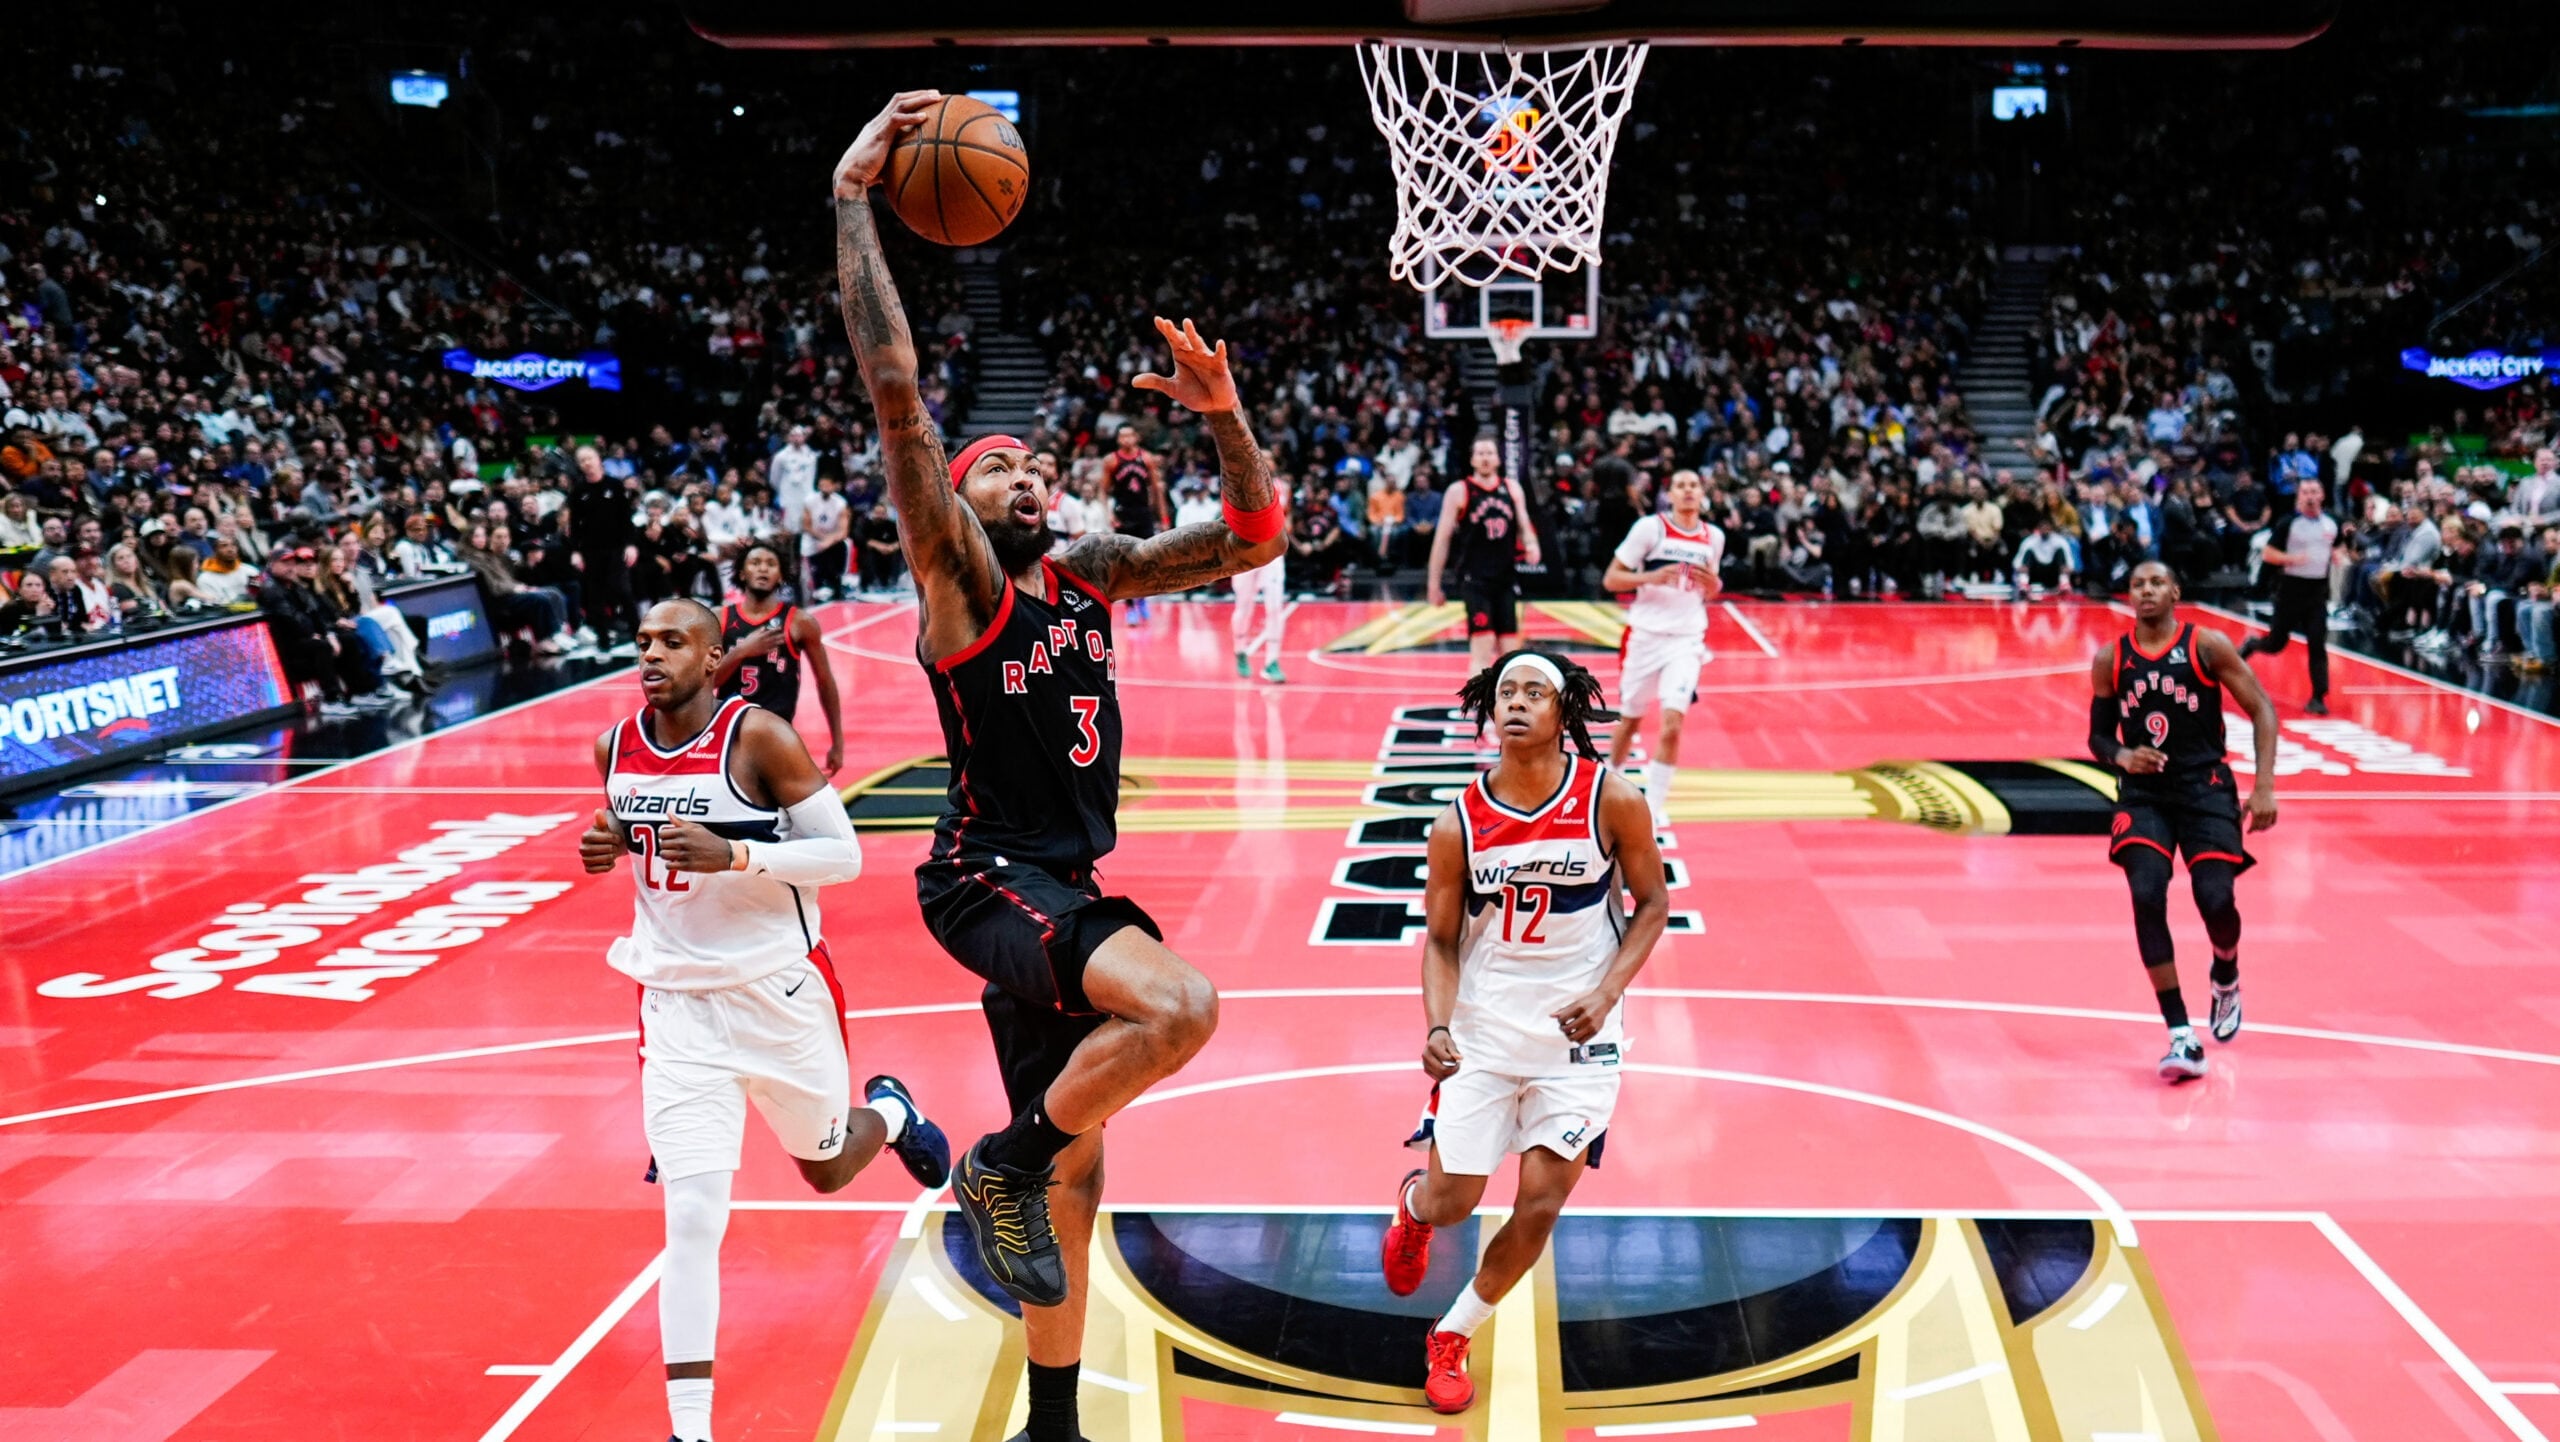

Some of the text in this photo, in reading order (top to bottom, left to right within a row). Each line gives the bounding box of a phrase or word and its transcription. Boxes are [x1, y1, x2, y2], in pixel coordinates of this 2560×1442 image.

[471, 358, 586, 378] JACKPOT CITY
[2426, 354, 2545, 377] JACKPOT CITY
[1484, 517, 1507, 540] 19
[740, 665, 759, 696] 5
[1068, 695, 1101, 767] 3
[2145, 711, 2169, 748] 9
[613, 786, 712, 816] wizards
[1475, 850, 1588, 885] wizards
[36, 811, 578, 1000] Scotiabank
[1502, 884, 1552, 944] 12
[234, 880, 574, 1002] Arena
